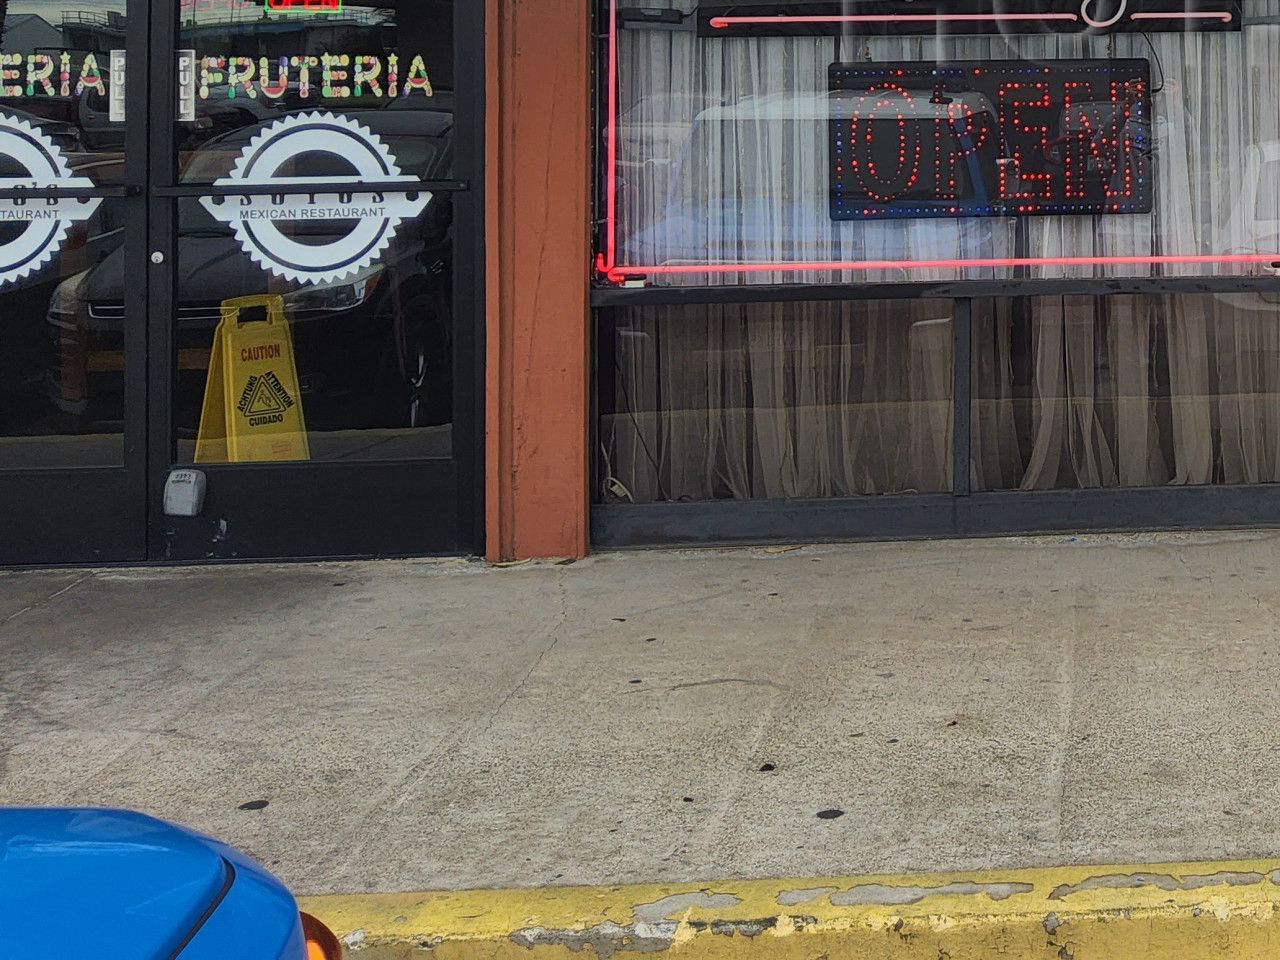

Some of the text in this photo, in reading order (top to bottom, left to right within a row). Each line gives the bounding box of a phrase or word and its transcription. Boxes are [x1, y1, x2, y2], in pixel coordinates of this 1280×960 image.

[179, 56, 190, 114] PULL
[199, 51, 434, 100] FRUTERIA
[850, 81, 1131, 202] OPEN
[239, 207, 387, 220] MEXICAN RESTAURANT
[241, 344, 281, 362] CAUTION
[236, 375, 258, 413] ACHTUNG
[264, 370, 295, 409] ATTENTION
[249, 414, 284, 427] CUIDADO
